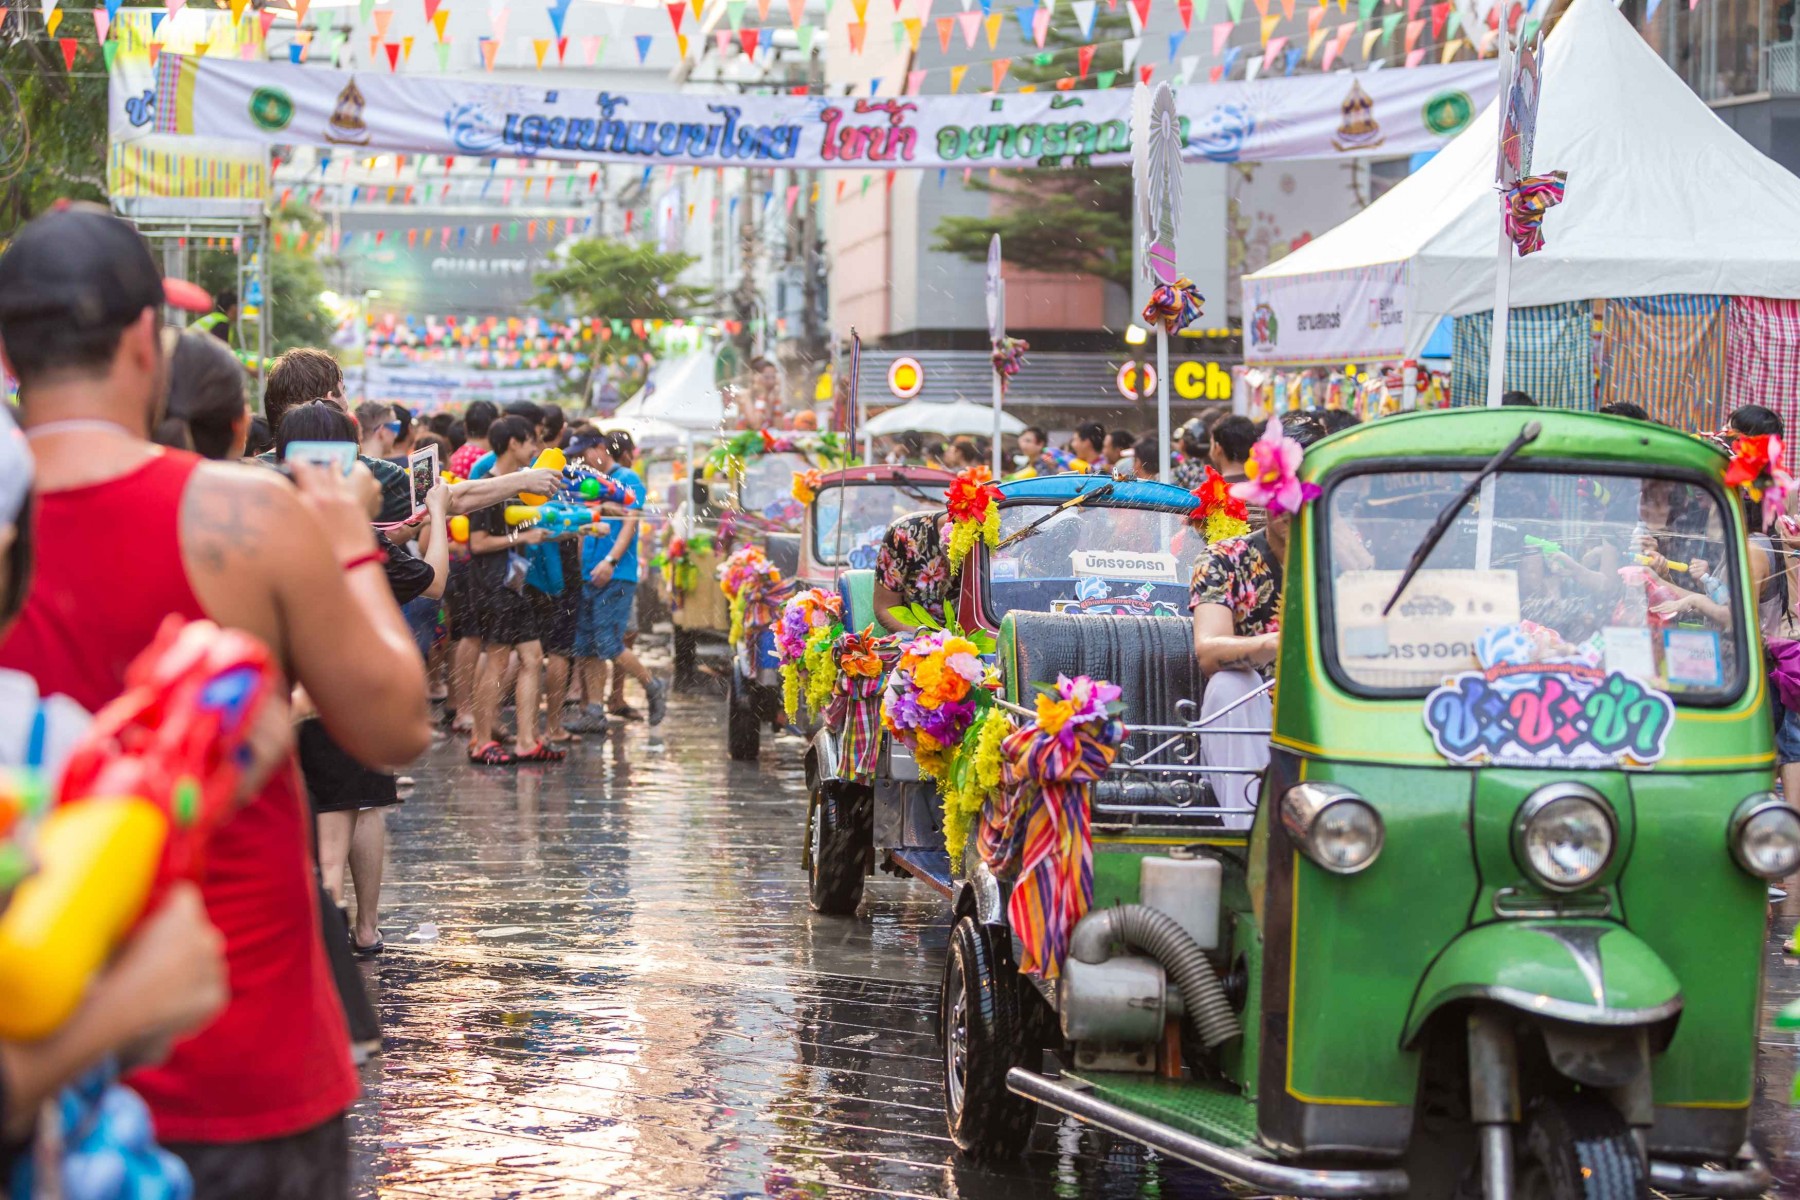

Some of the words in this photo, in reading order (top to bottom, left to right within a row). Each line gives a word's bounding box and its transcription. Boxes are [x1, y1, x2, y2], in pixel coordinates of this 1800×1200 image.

[503, 90, 802, 159] เล่นน้ำแบบไทย
[1085, 553, 1165, 571] บัตรจอดรถ
